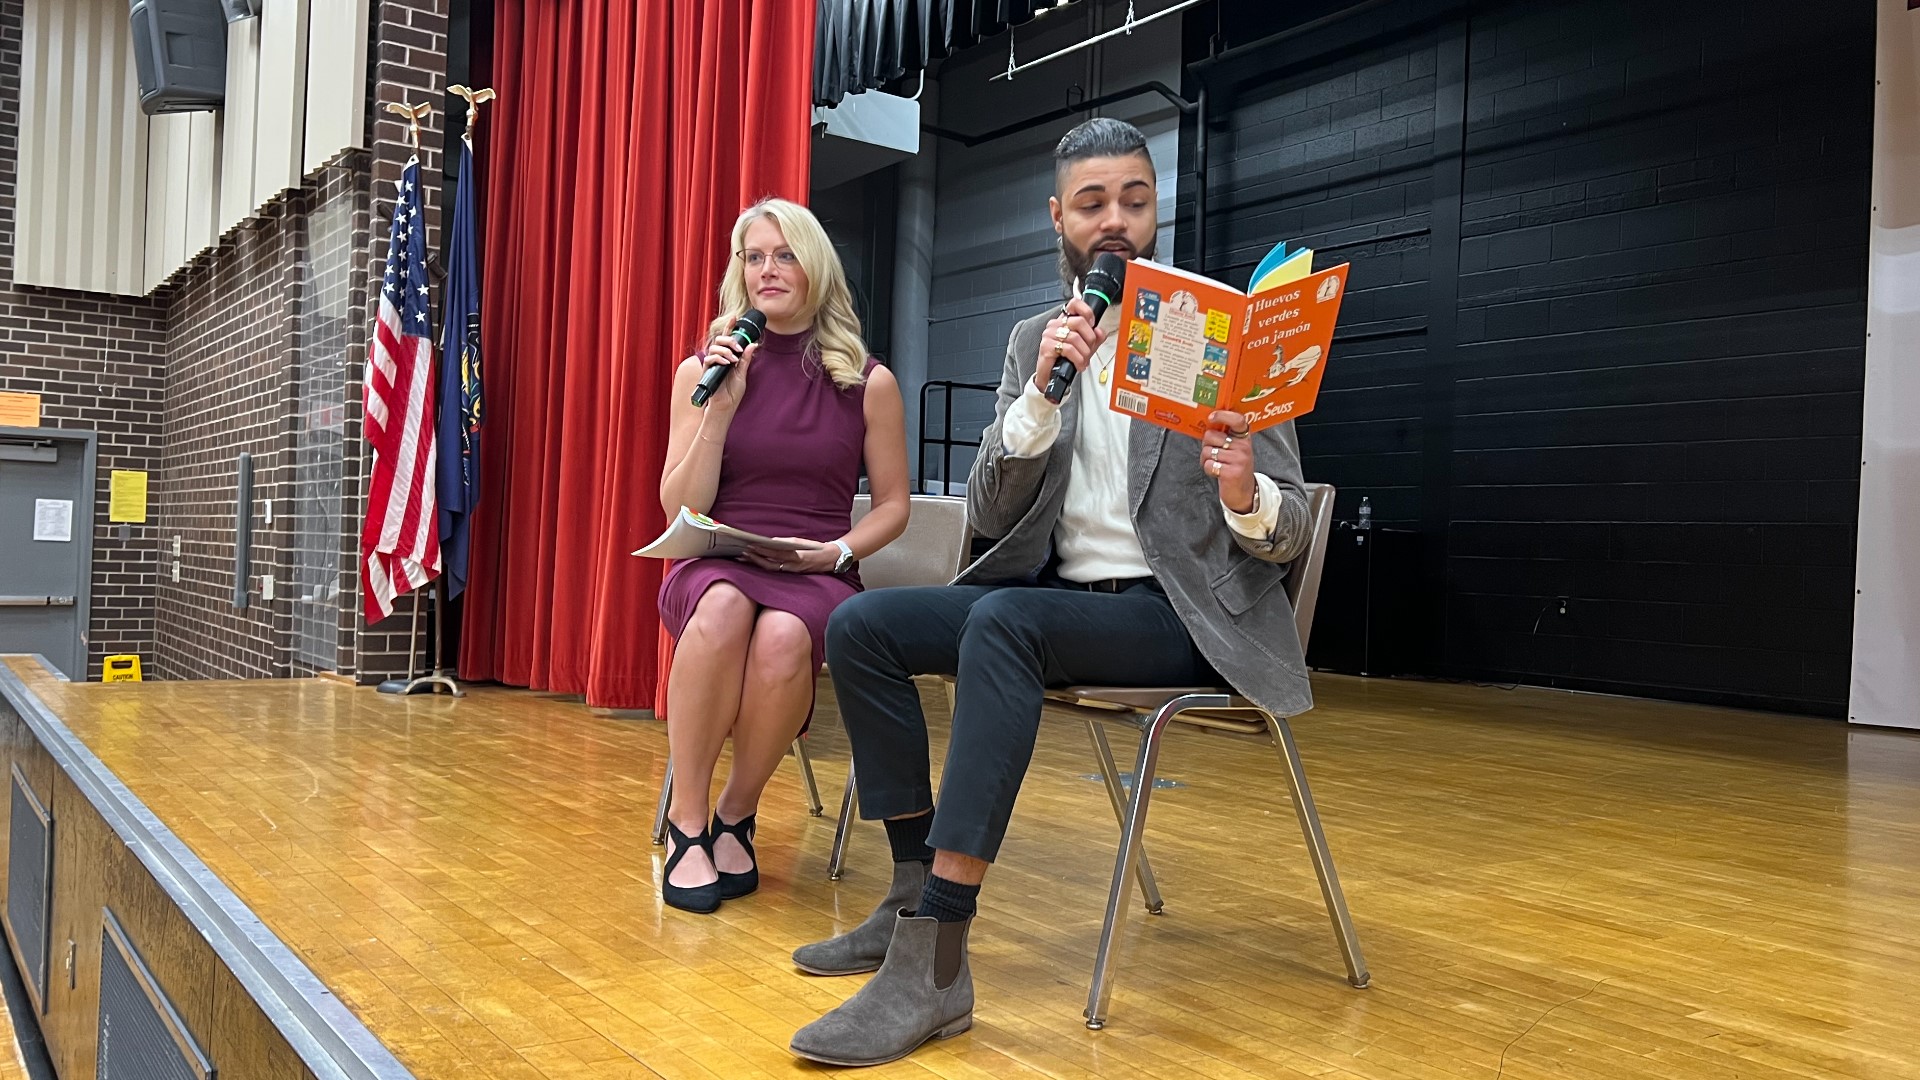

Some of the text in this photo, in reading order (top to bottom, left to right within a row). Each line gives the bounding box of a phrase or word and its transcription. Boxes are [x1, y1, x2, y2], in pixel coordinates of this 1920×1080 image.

[1255, 289, 1301, 313] Huevos
[1258, 307, 1301, 328] verdes
[1247, 320, 1311, 350] con jamón
[1244, 400, 1295, 425] Dr. Seuss
